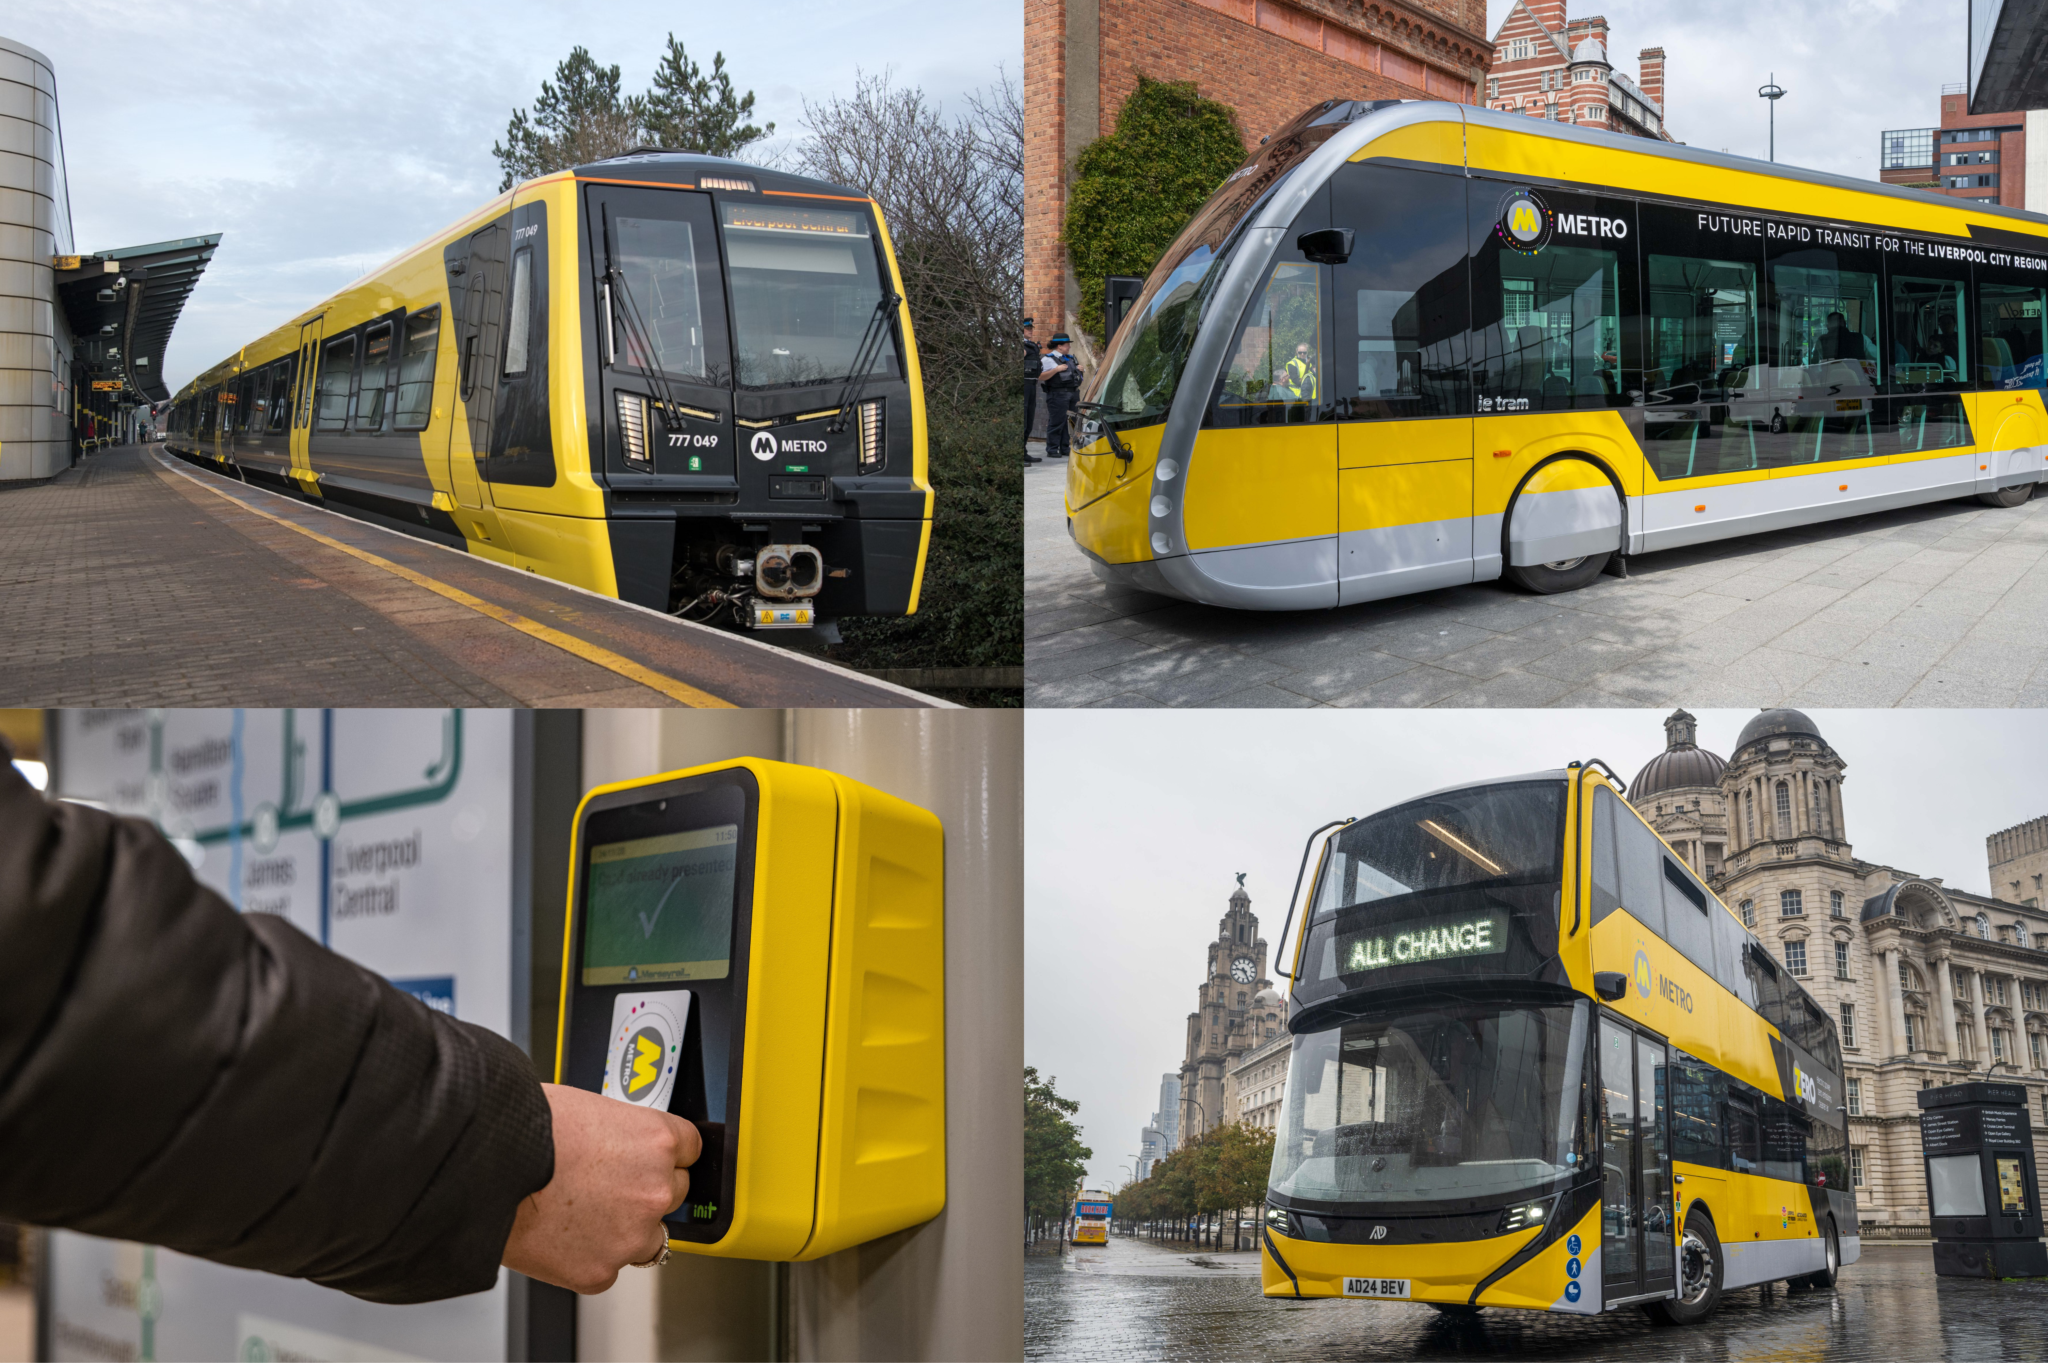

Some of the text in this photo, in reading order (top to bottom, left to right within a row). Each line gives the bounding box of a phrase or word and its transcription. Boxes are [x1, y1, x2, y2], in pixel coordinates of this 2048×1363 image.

[515, 224, 538, 241] 777 049
[1557, 213, 1628, 239] METRO
[1698, 214, 2048, 271] FUTURE RAPID TRANSIT FOR THE LIVERPOOL CITY REGION
[1495, 395, 1529, 411] tram
[668, 434, 718, 448] 777 049
[781, 440, 827, 453] METRO
[716, 830, 737, 841] 11:50
[334, 828, 422, 879] Liverpool
[672, 853, 733, 881] presented
[334, 880, 398, 921] Central
[1352, 920, 1492, 967] ALL CHANGE
[1660, 974, 1693, 1014] METRO
[622, 1043, 635, 1086] METRO
[1794, 1066, 1816, 1105] ZERO
[693, 1201, 717, 1219] init
[1348, 1279, 1405, 1295] AD24 BEV
